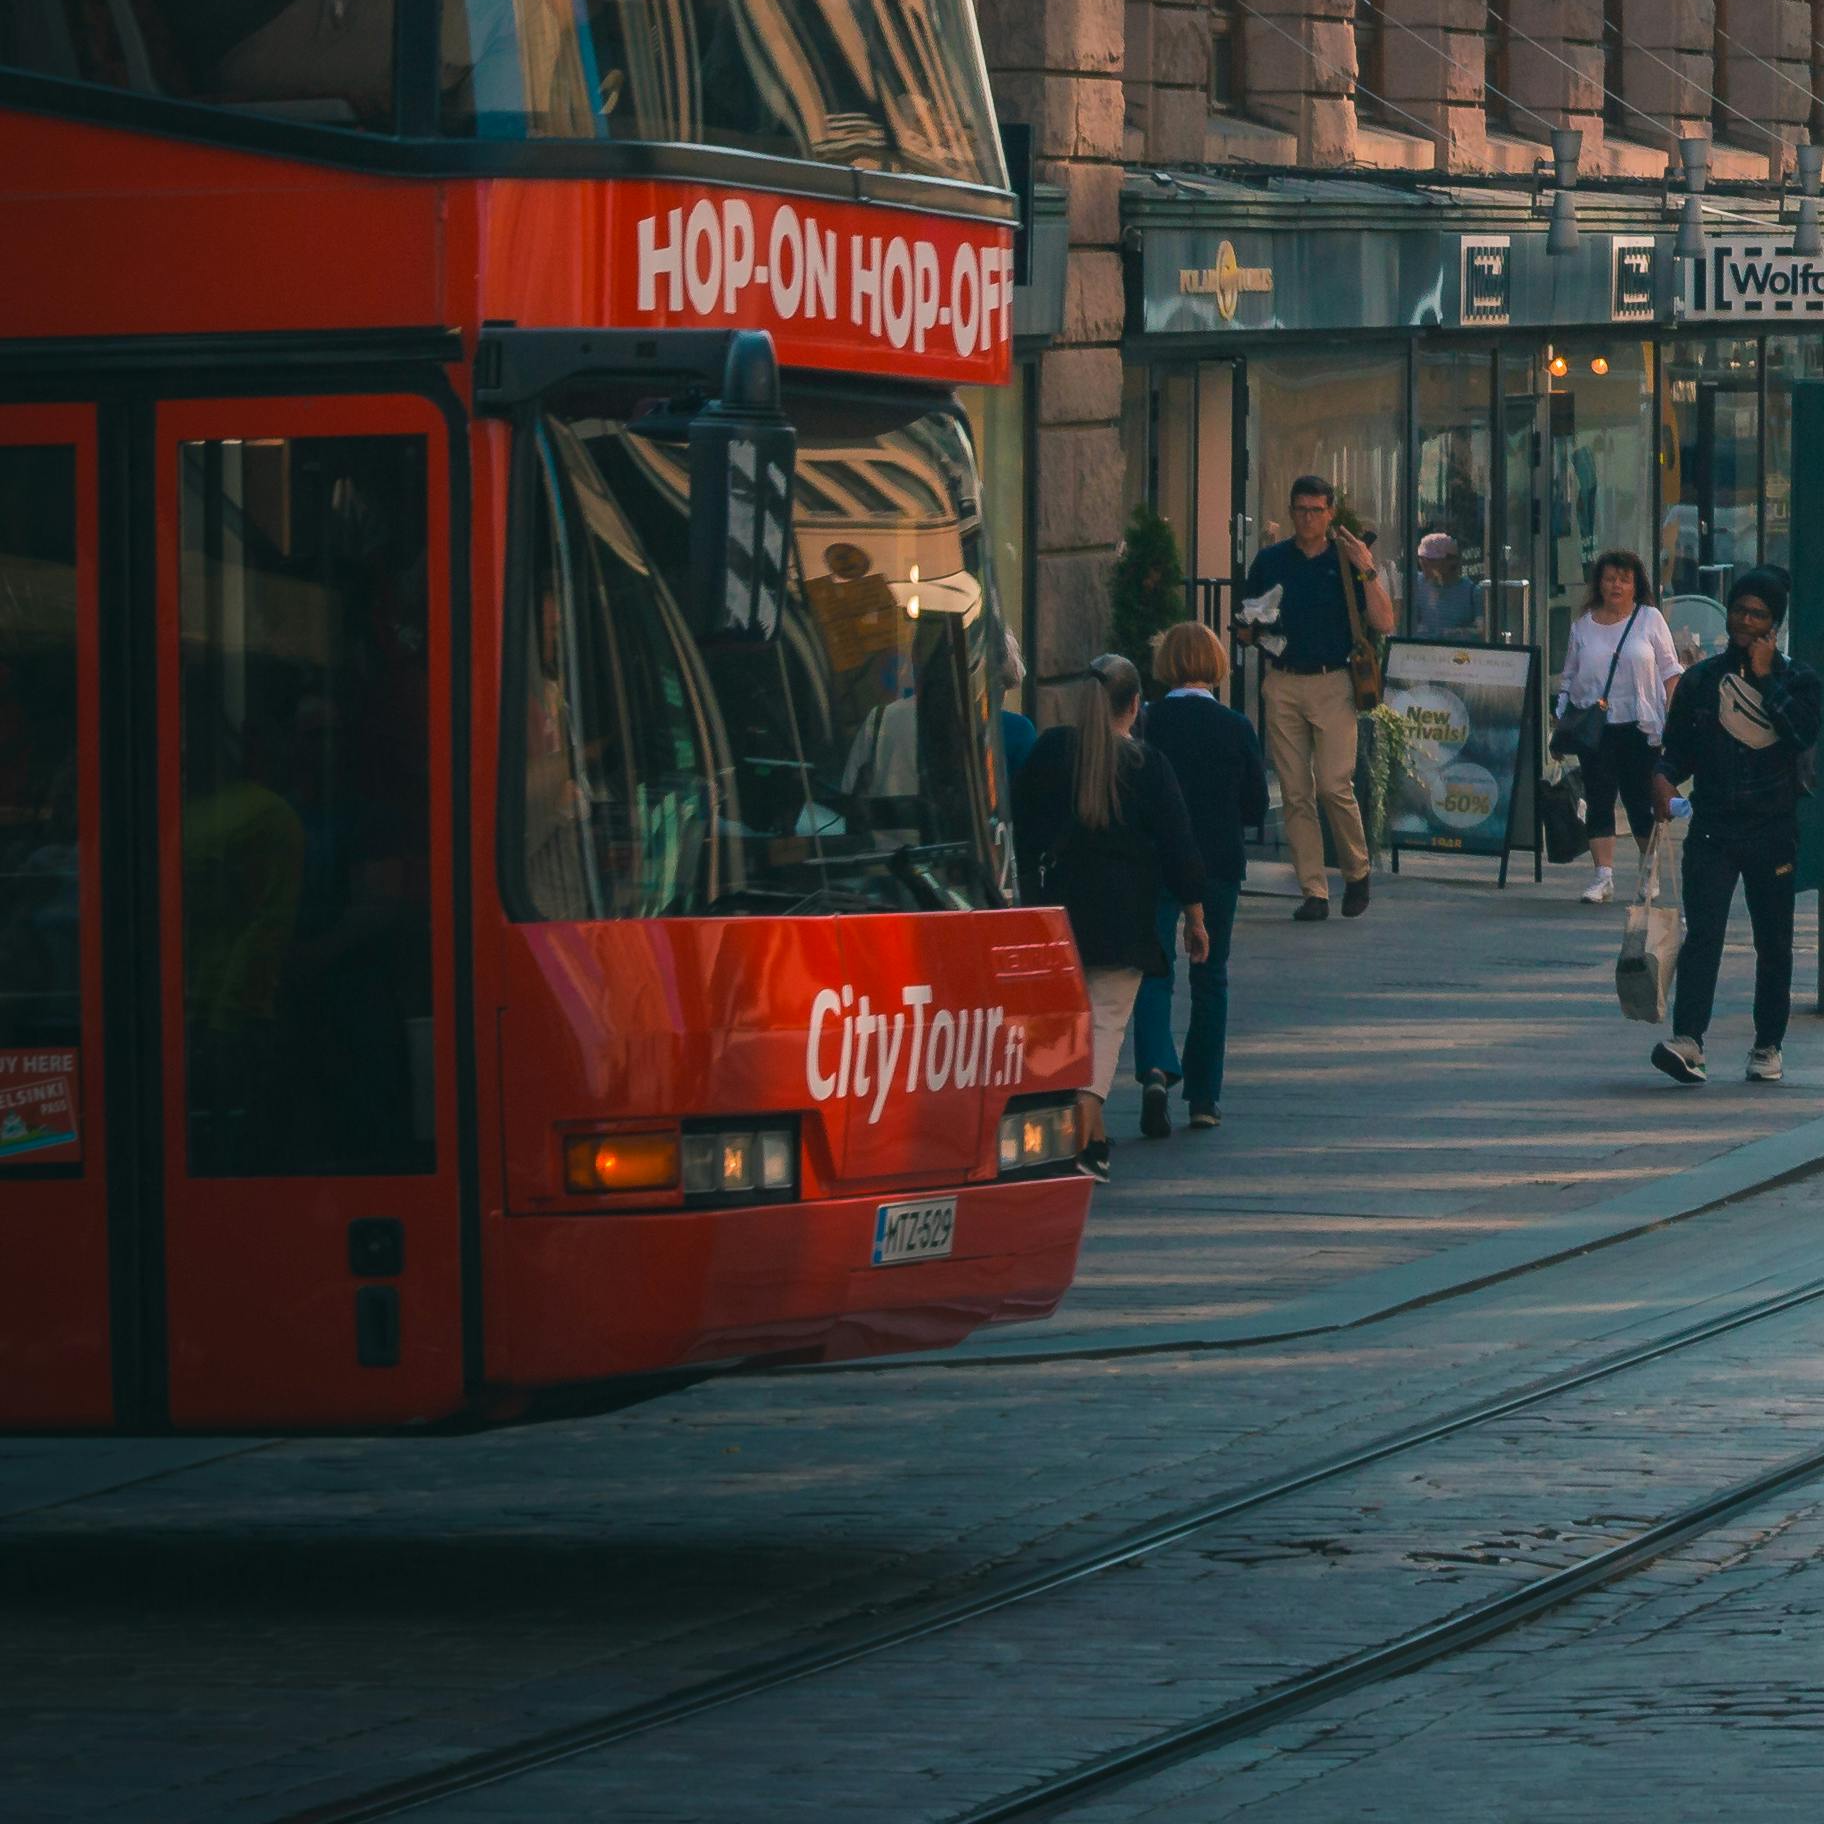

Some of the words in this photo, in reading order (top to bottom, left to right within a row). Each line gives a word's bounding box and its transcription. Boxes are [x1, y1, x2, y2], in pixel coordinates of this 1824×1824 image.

[637, 199, 838, 320] HOP-ON
[850, 236, 1014, 357] HOP-OFF
[1406, 705, 1451, 725] New
[1434, 794, 1492, 816] -60%
[22, 1054, 73, 1073] HERE
[806, 984, 1026, 1125] CityTour.fi
